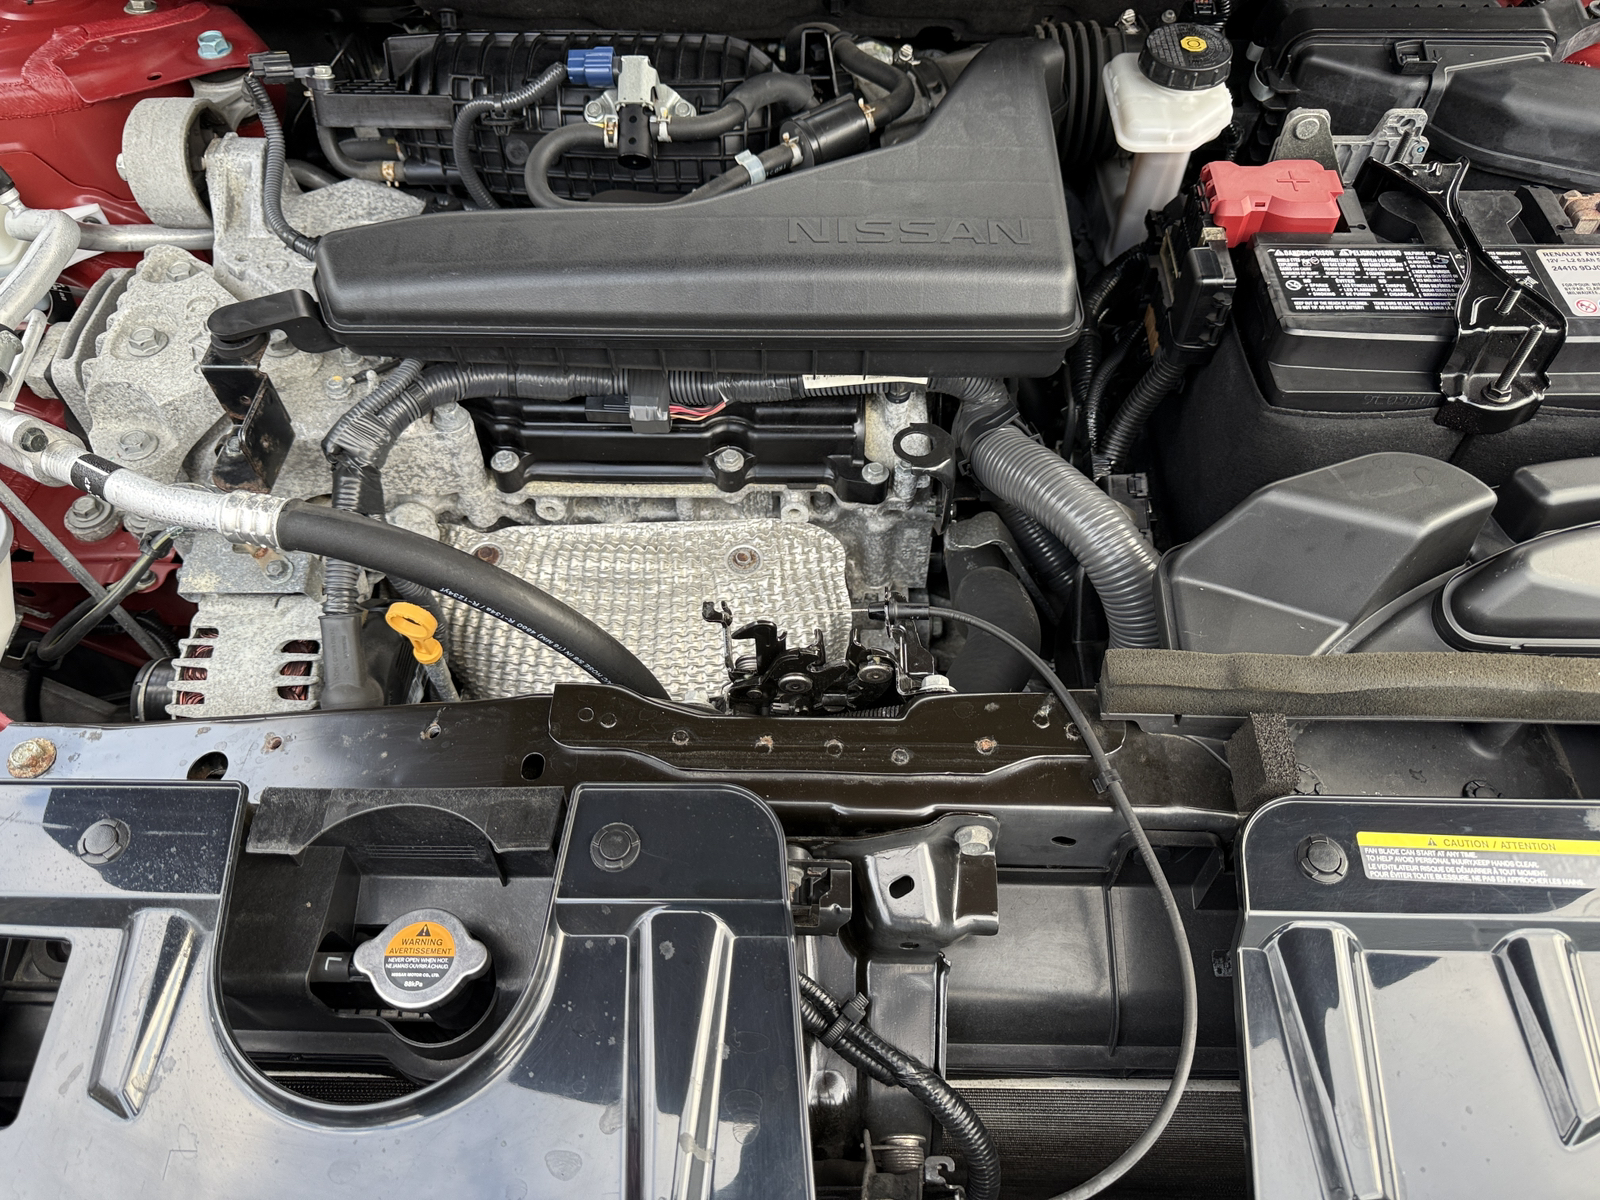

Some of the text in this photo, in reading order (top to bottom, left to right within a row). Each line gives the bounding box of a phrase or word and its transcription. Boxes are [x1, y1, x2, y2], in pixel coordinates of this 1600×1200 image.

[788, 216, 1031, 244] NISSAN
[440, 587, 480, 607] R-1234yf
[486, 607, 515, 624] R-134a
[583, 663, 603, 677] HOSE
[1443, 838, 1489, 848] CAUTION
[1501, 841, 1556, 851] ATTENTION
[1390, 870, 1412, 878] ÉVITER
[1508, 877, 1548, 885] APPROCHER
